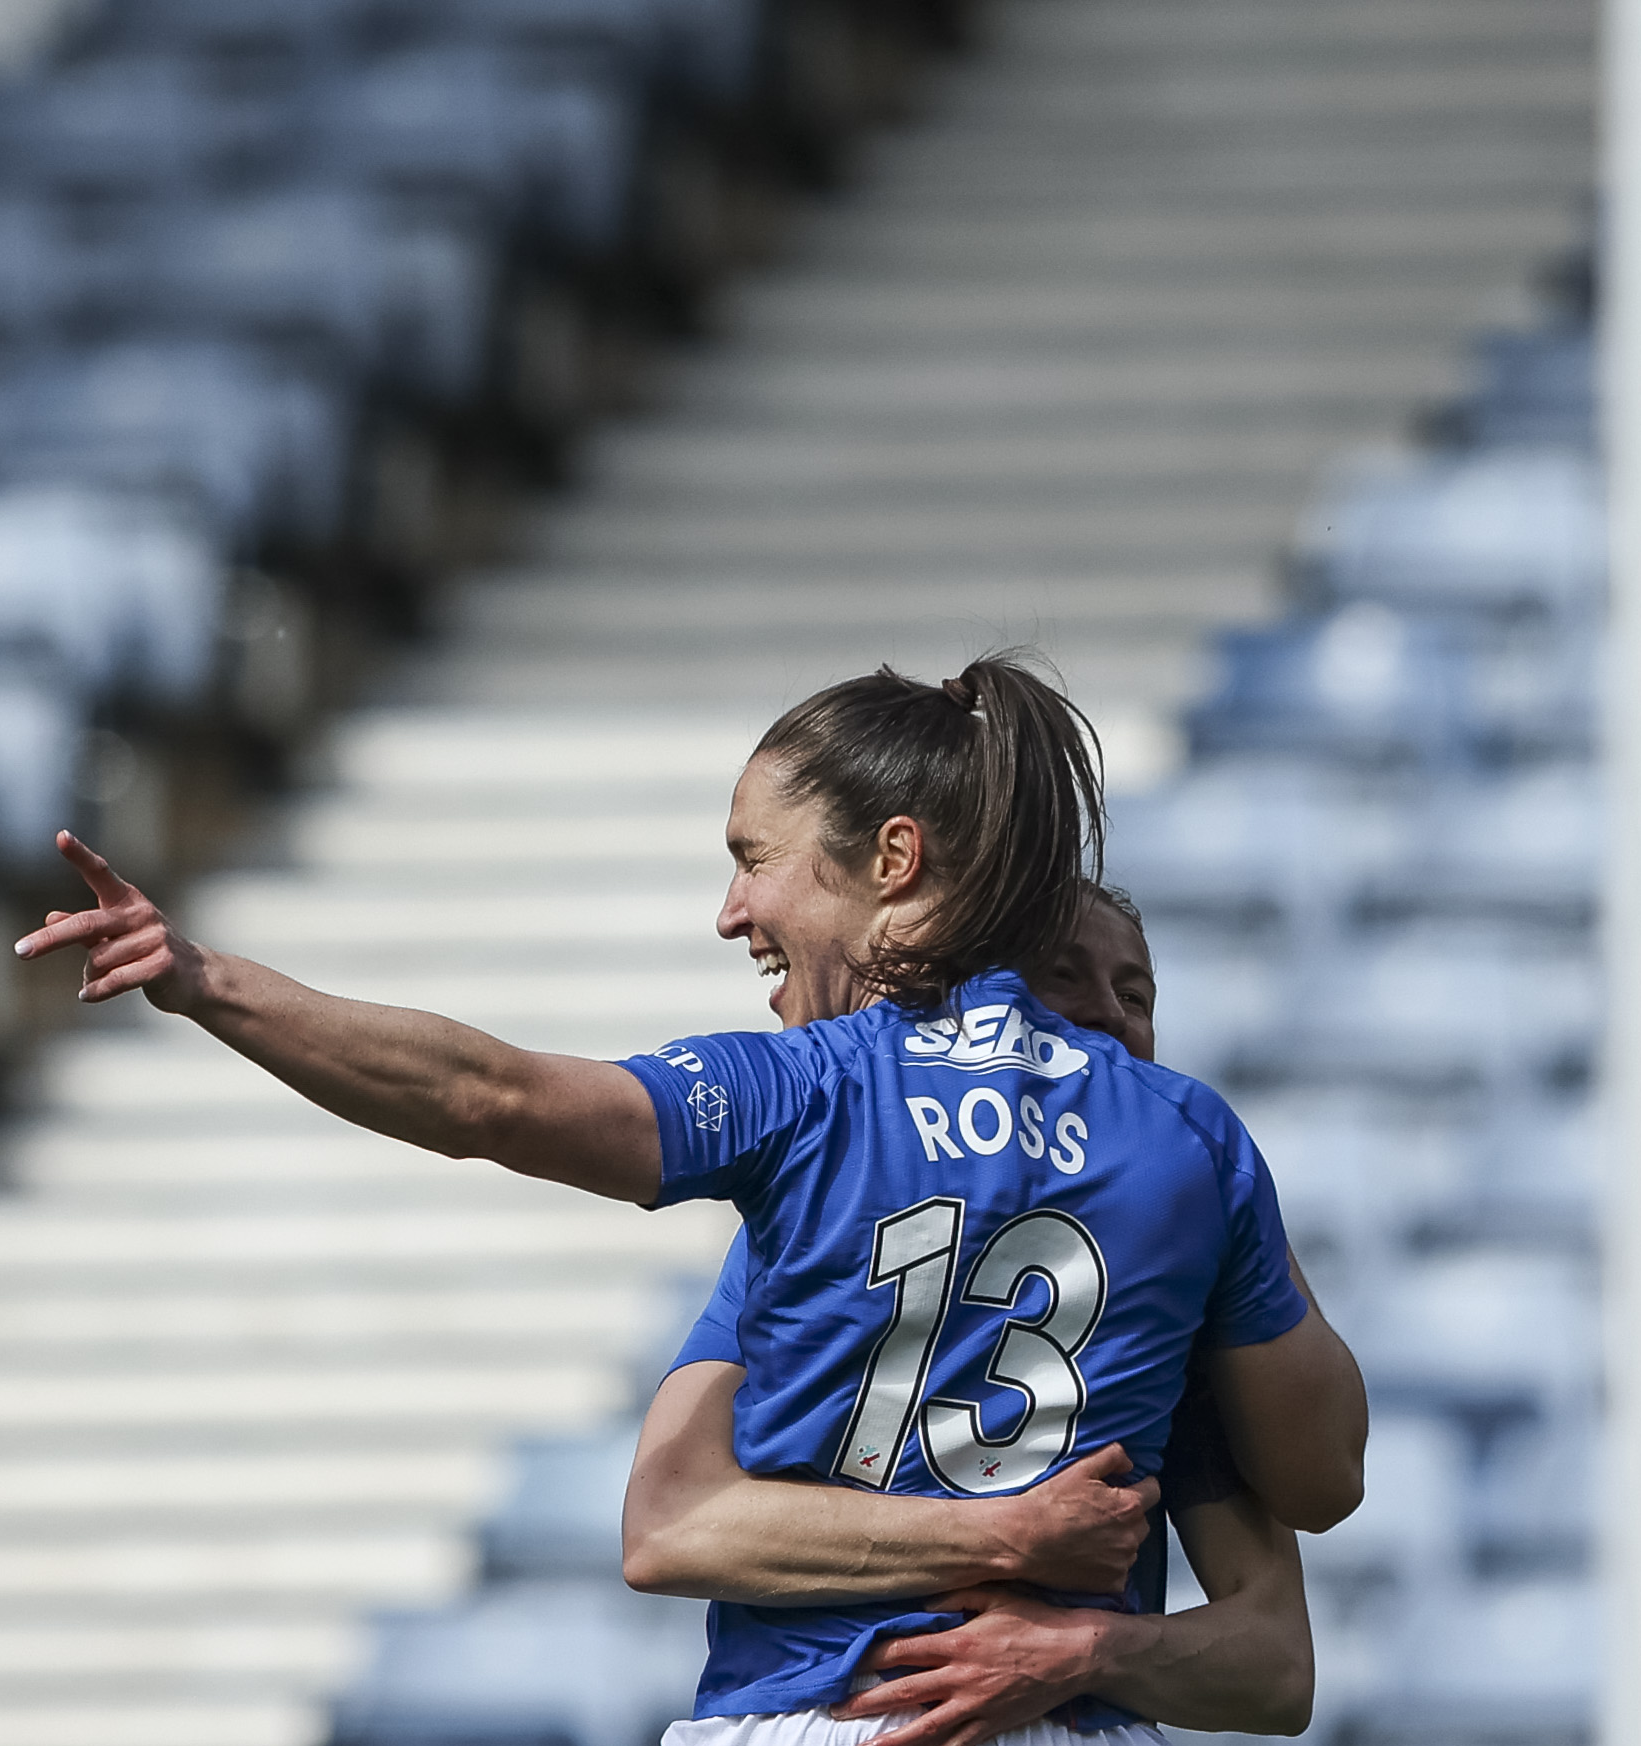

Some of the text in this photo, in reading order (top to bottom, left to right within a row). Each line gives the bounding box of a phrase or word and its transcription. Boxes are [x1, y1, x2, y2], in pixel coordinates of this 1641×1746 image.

[902, 1004, 1089, 1079] SEKO
[905, 1087, 1088, 1175] ROSS
[832, 1195, 1108, 1495] 13
